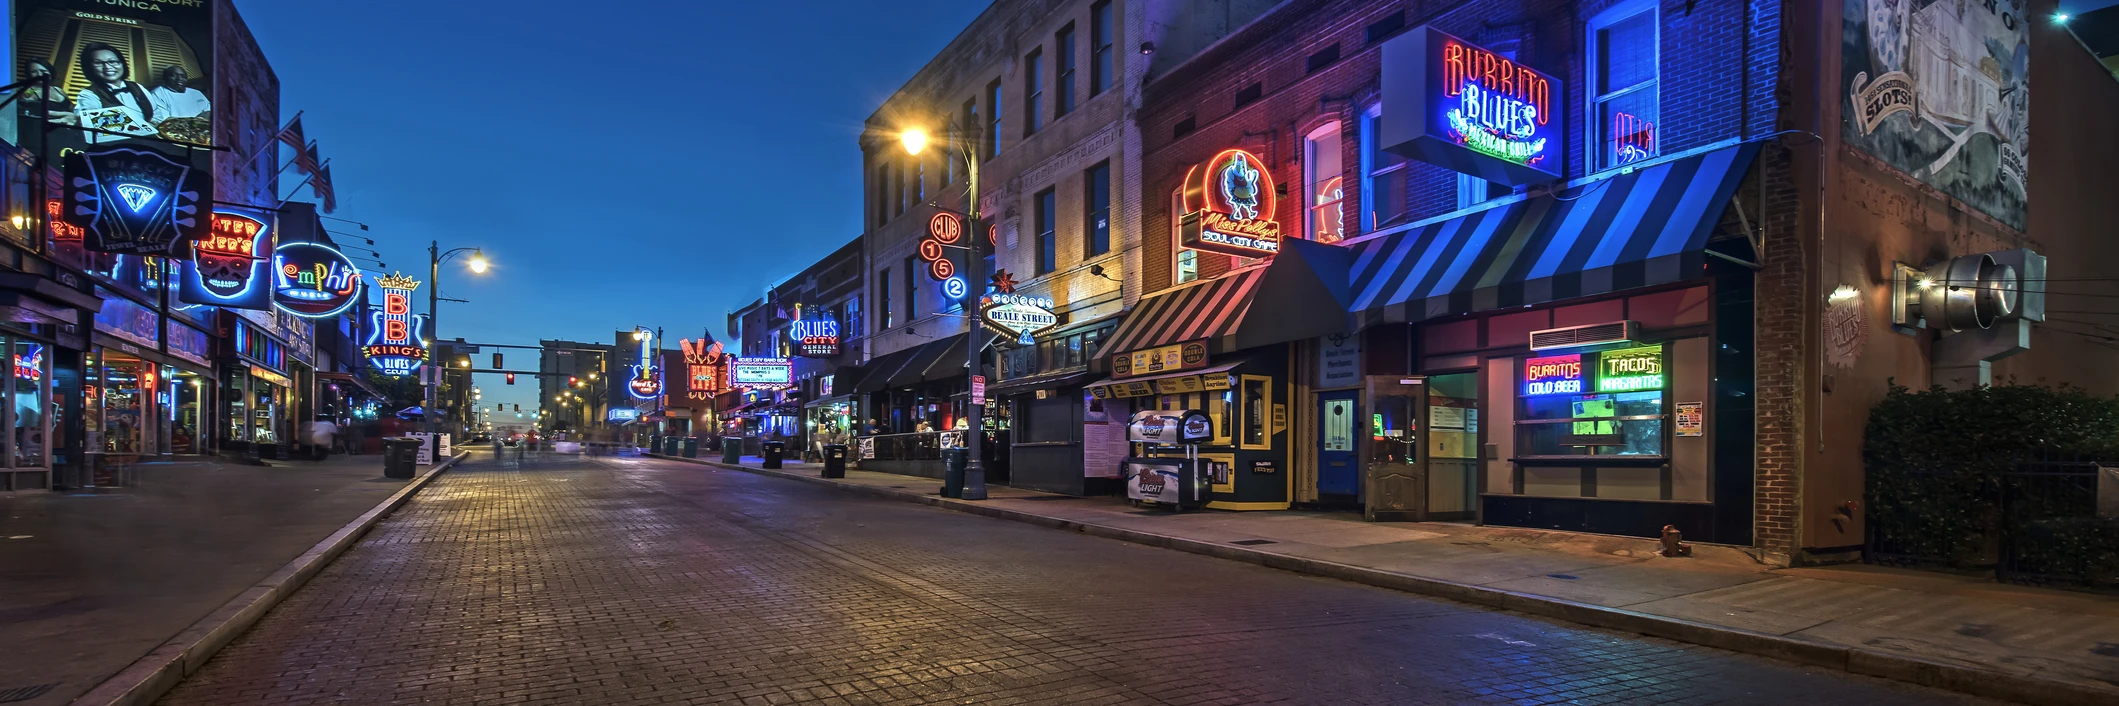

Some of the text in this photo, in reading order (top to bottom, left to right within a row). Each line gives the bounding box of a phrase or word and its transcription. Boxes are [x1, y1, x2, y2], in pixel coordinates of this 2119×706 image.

[94, 0, 161, 12] UNICA
[75, 11, 138, 25] GOLD STRIKE
[1444, 44, 1549, 126] BURRITO
[1464, 84, 1537, 137] BLUES
[1866, 89, 1912, 124] SLOTS!
[1467, 124, 1533, 156] MEXICAN GRILL
[211, 216, 256, 235] ATER
[934, 216, 958, 240] CLUB
[1202, 213, 1237, 231] Miss
[1203, 230, 1230, 243] SOUL
[1232, 236, 1252, 246] CITY
[105, 241, 136, 251] JEWEL
[136, 243, 168, 253] BEALE
[991, 311, 1054, 323] BEALE STREET
[790, 320, 836, 340] BLUES
[803, 336, 837, 344] CITY
[370, 346, 421, 357] KING'S
[1184, 348, 1203, 356] DOUBLE
[384, 358, 410, 369] BLUES
[691, 365, 716, 375] BLUES
[1529, 362, 1581, 380] BURRITOS
[1608, 357, 1657, 376] TACOS
[691, 378, 717, 390] CAFE
[1528, 379, 1581, 395] COLD BEER
[1601, 375, 1663, 390] MARGARITAS
[1143, 427, 1162, 435] LIGHT
[1139, 467, 1165, 484] Coors
[1140, 483, 1162, 493] LIGHT
